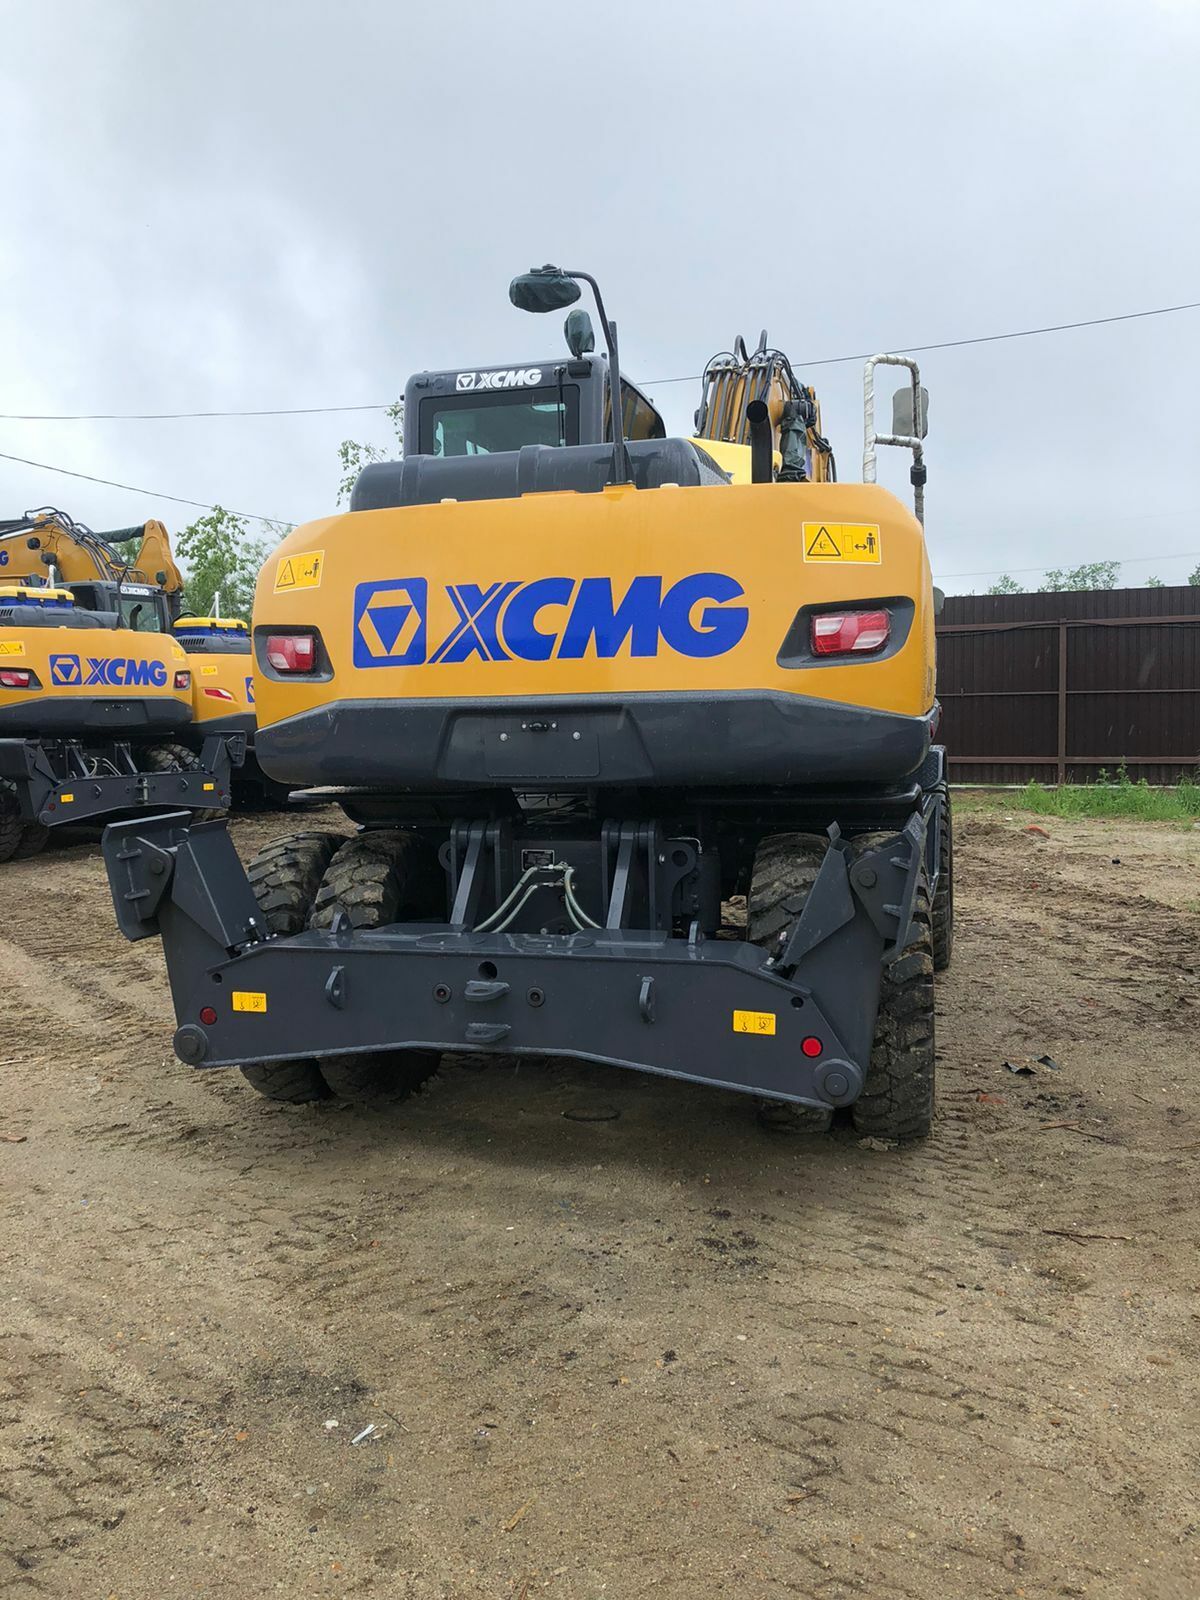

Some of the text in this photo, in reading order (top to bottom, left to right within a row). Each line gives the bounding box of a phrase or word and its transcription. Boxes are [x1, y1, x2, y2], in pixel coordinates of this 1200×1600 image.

[474, 368, 542, 389] XCMG
[427, 572, 749, 664] XCMG
[83, 658, 167, 687] XCMG
